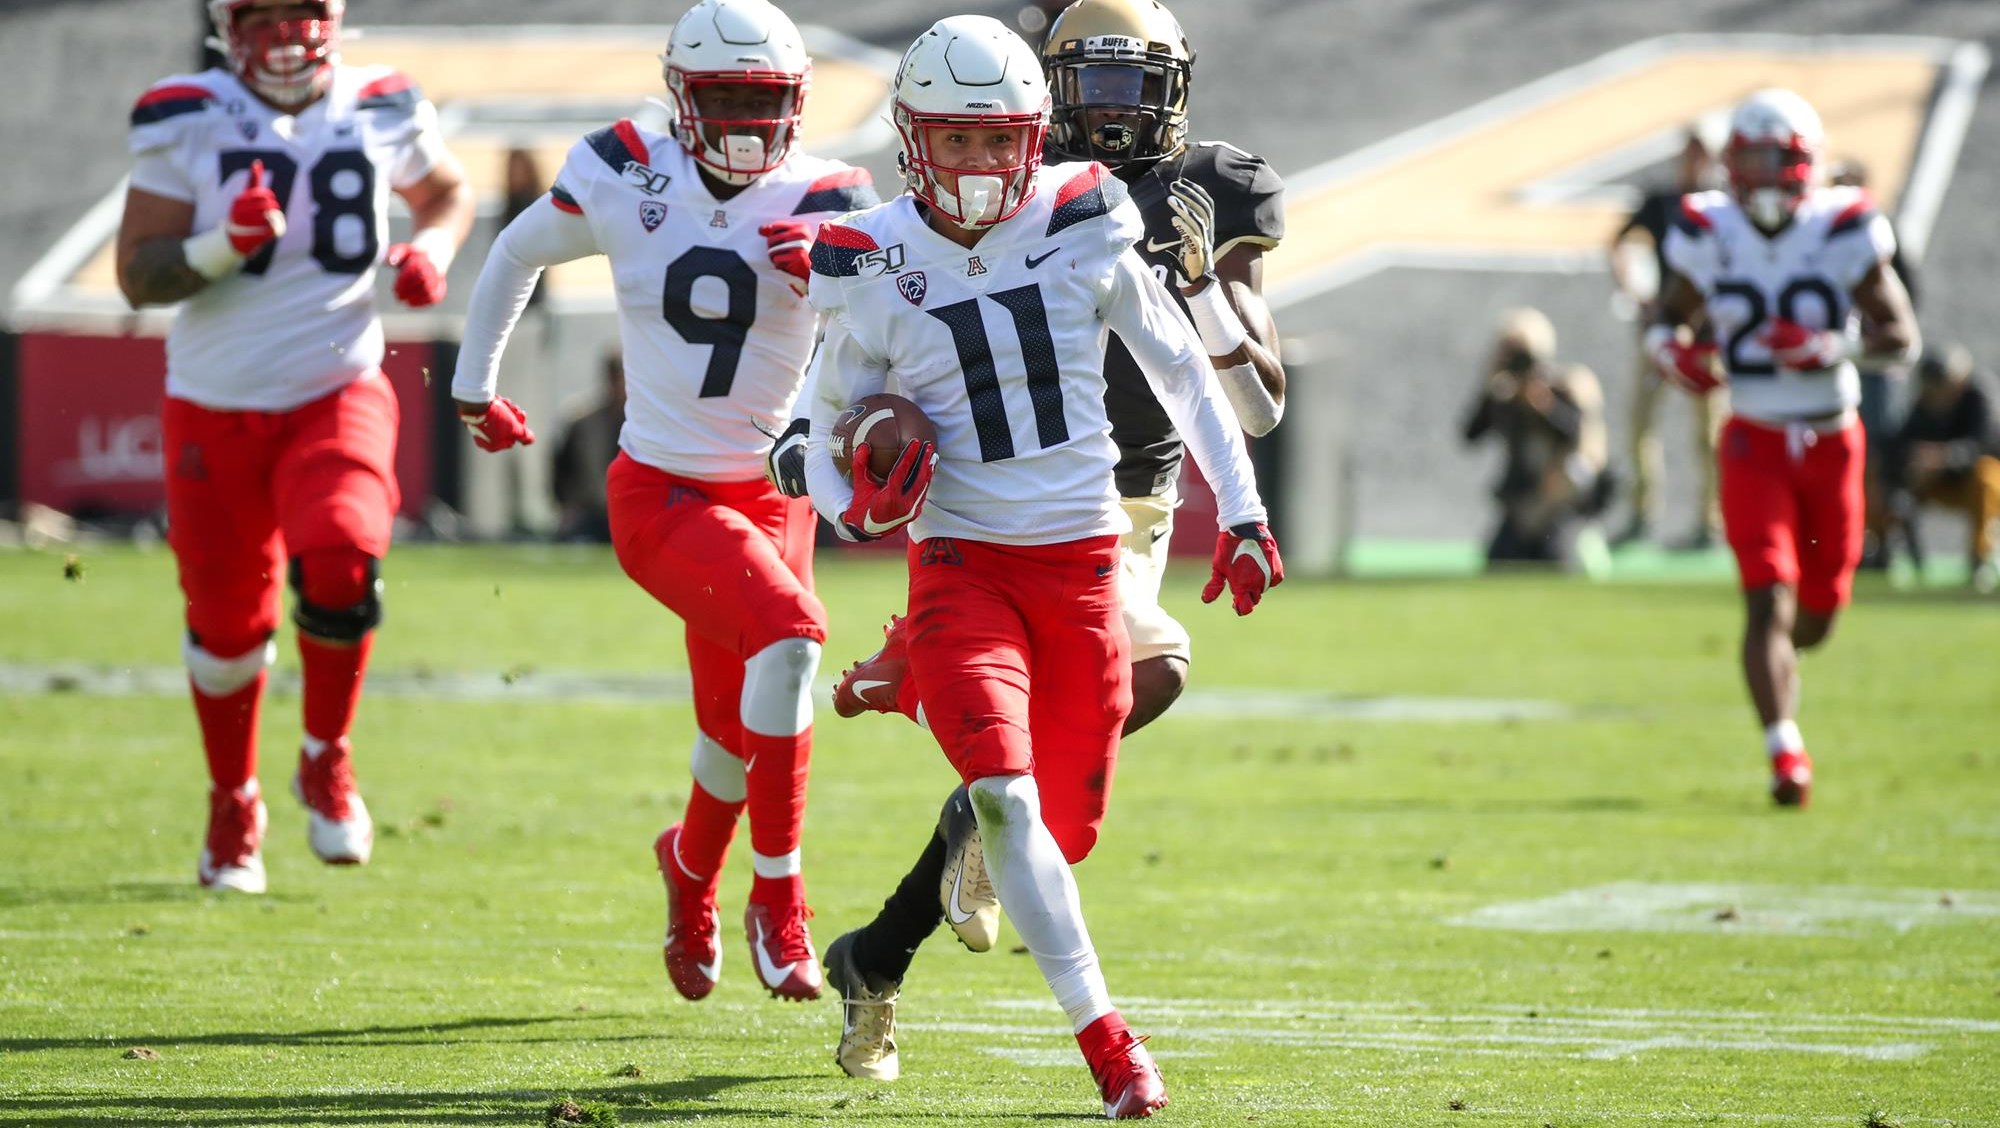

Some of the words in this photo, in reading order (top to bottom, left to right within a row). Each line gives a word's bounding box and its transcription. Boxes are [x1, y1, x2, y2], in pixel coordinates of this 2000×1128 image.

[1101, 37, 1129, 48] BUFFS
[623, 160, 671, 196] 150
[219, 150, 378, 276] 78
[851, 242, 905, 276] 150
[967, 255, 987, 277] A
[898, 272, 926, 295] PAC
[907, 286, 923, 300] 12
[662, 244, 758, 399] 9
[924, 281, 1070, 464] 11
